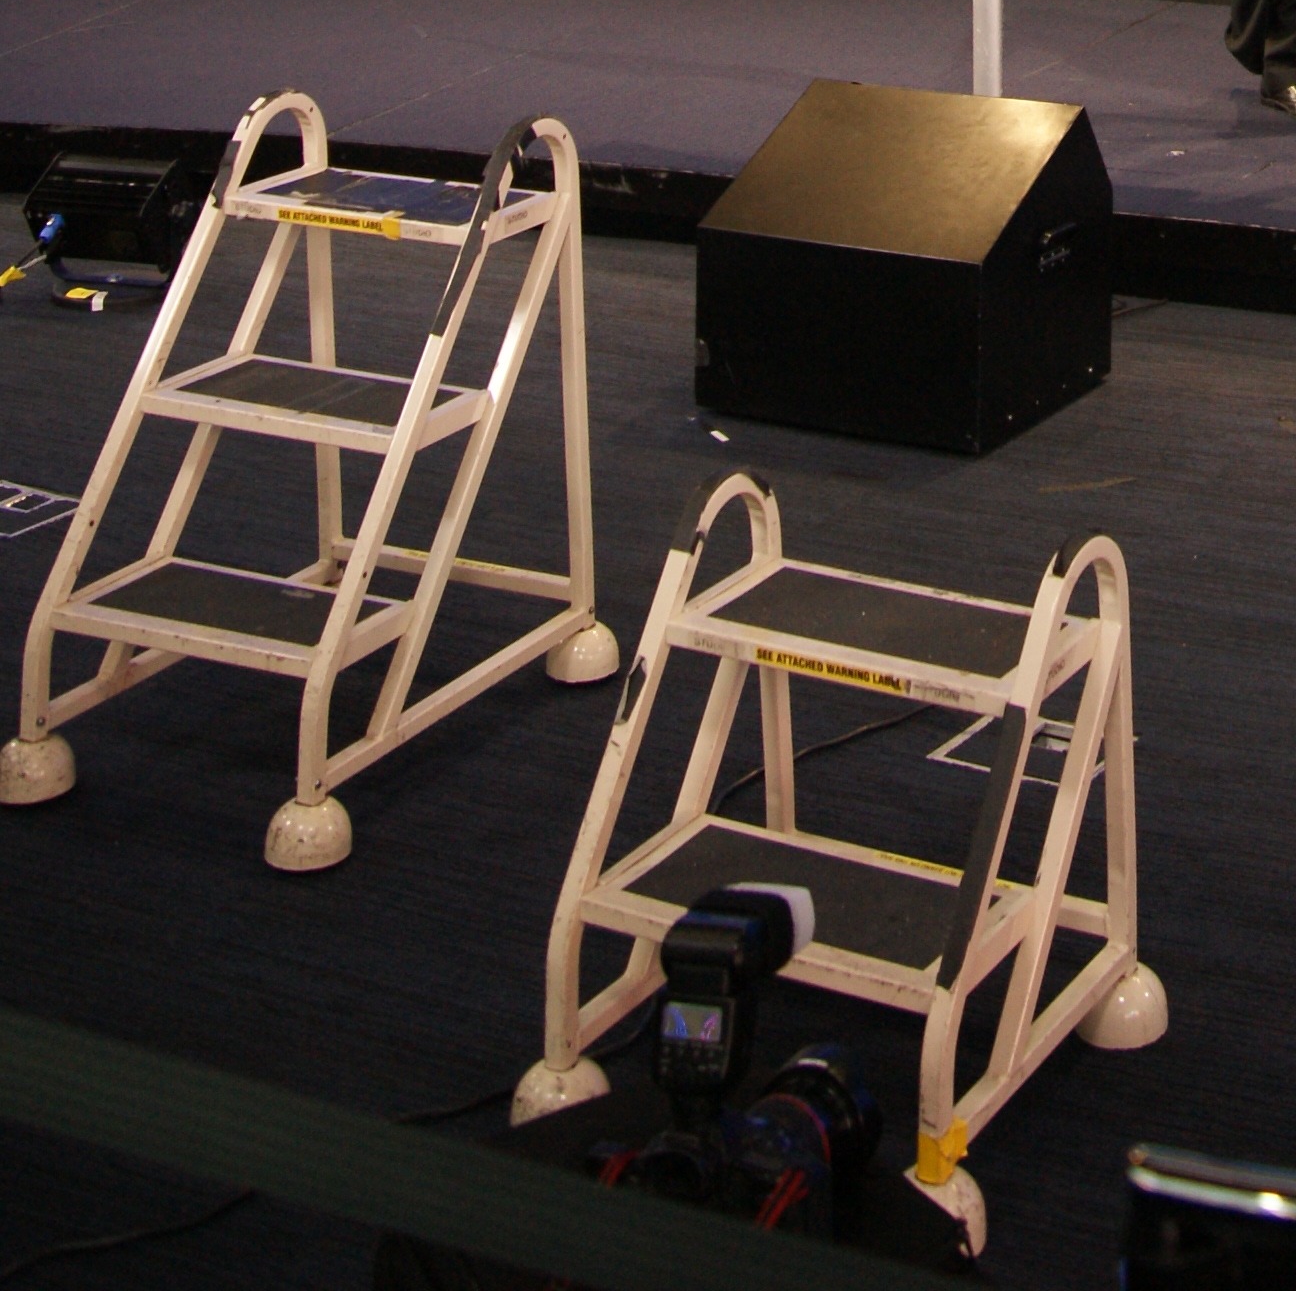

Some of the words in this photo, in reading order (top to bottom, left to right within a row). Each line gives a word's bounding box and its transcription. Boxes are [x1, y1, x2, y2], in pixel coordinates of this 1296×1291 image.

[278, 209, 291, 220] SEE
[292, 211, 327, 224] ATTACHED
[362, 220, 383, 232] LABEL
[756, 647, 774, 662] SEE
[776, 651, 824, 672] ATTACHED
[826, 663, 870, 683] WARNING
